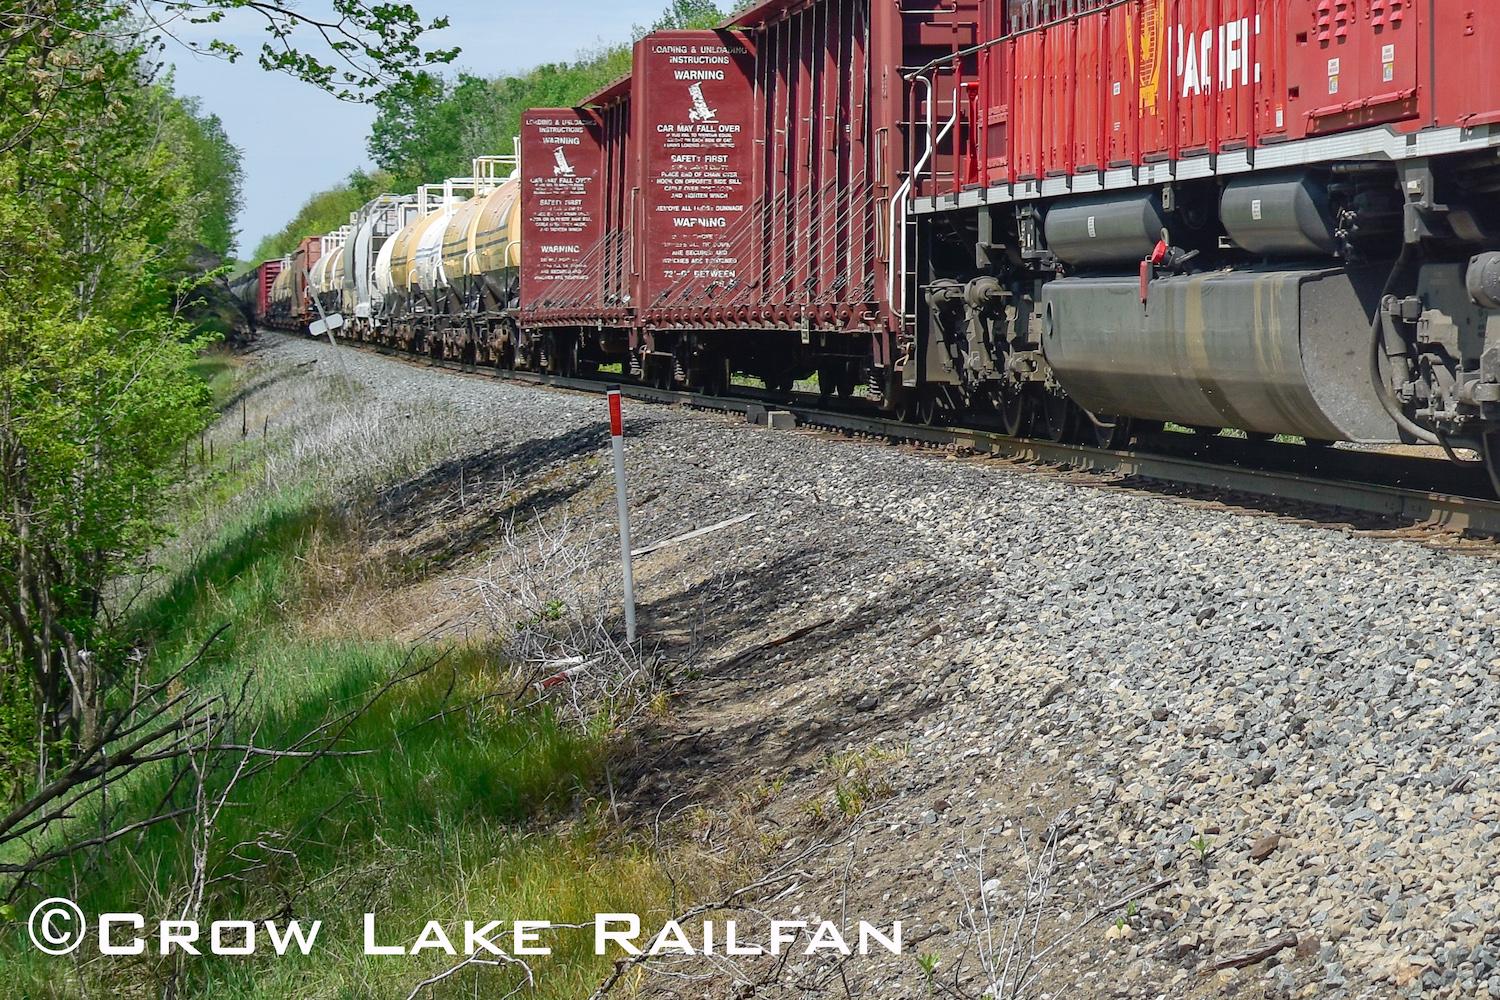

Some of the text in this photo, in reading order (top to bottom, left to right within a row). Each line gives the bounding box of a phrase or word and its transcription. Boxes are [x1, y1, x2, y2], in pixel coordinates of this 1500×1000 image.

[652, 45, 687, 54] LOADING
[669, 56, 730, 64] INSTRUCTIONS
[674, 70, 724, 80] WARNING
[542, 137, 580, 145] WARNING
[673, 217, 726, 227] WARNING
